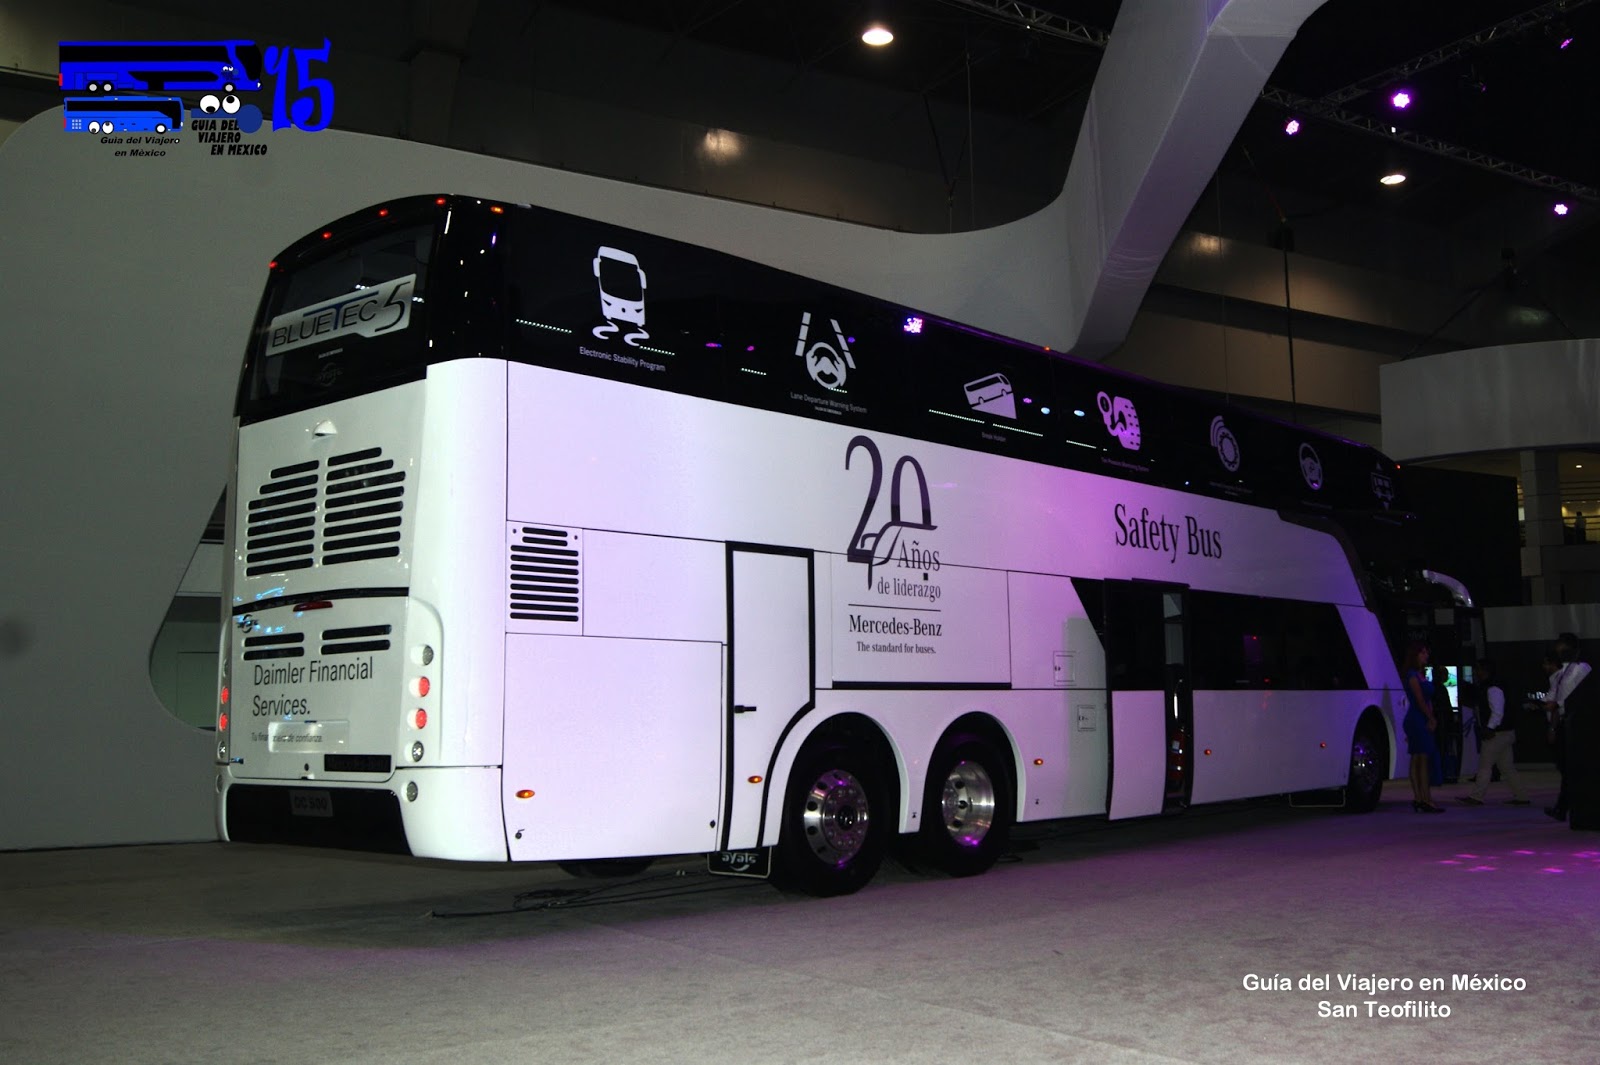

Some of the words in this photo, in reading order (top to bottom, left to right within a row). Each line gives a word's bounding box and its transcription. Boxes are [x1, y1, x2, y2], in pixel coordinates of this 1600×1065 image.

[374, 281, 411, 333] 5
[579, 346, 612, 361] Electronic
[613, 353, 639, 368] Stability
[639, 359, 666, 372] Program
[845, 435, 938, 565] 20
[1114, 503, 1180, 564] Safety
[1185, 515, 1222, 559] Bus
[897, 539, 940, 572] Años
[877, 576, 890, 595] de
[893, 577, 941, 603] liderazgo
[849, 614, 942, 637] Mercedes-Benz
[857, 641, 870, 652] The
[872, 642, 902, 653] standard
[904, 643, 914, 653] for
[915, 643, 936, 654] buses.
[253, 661, 305, 686] Daimler
[309, 655, 373, 683] Financial
[252, 693, 311, 717] Services.
